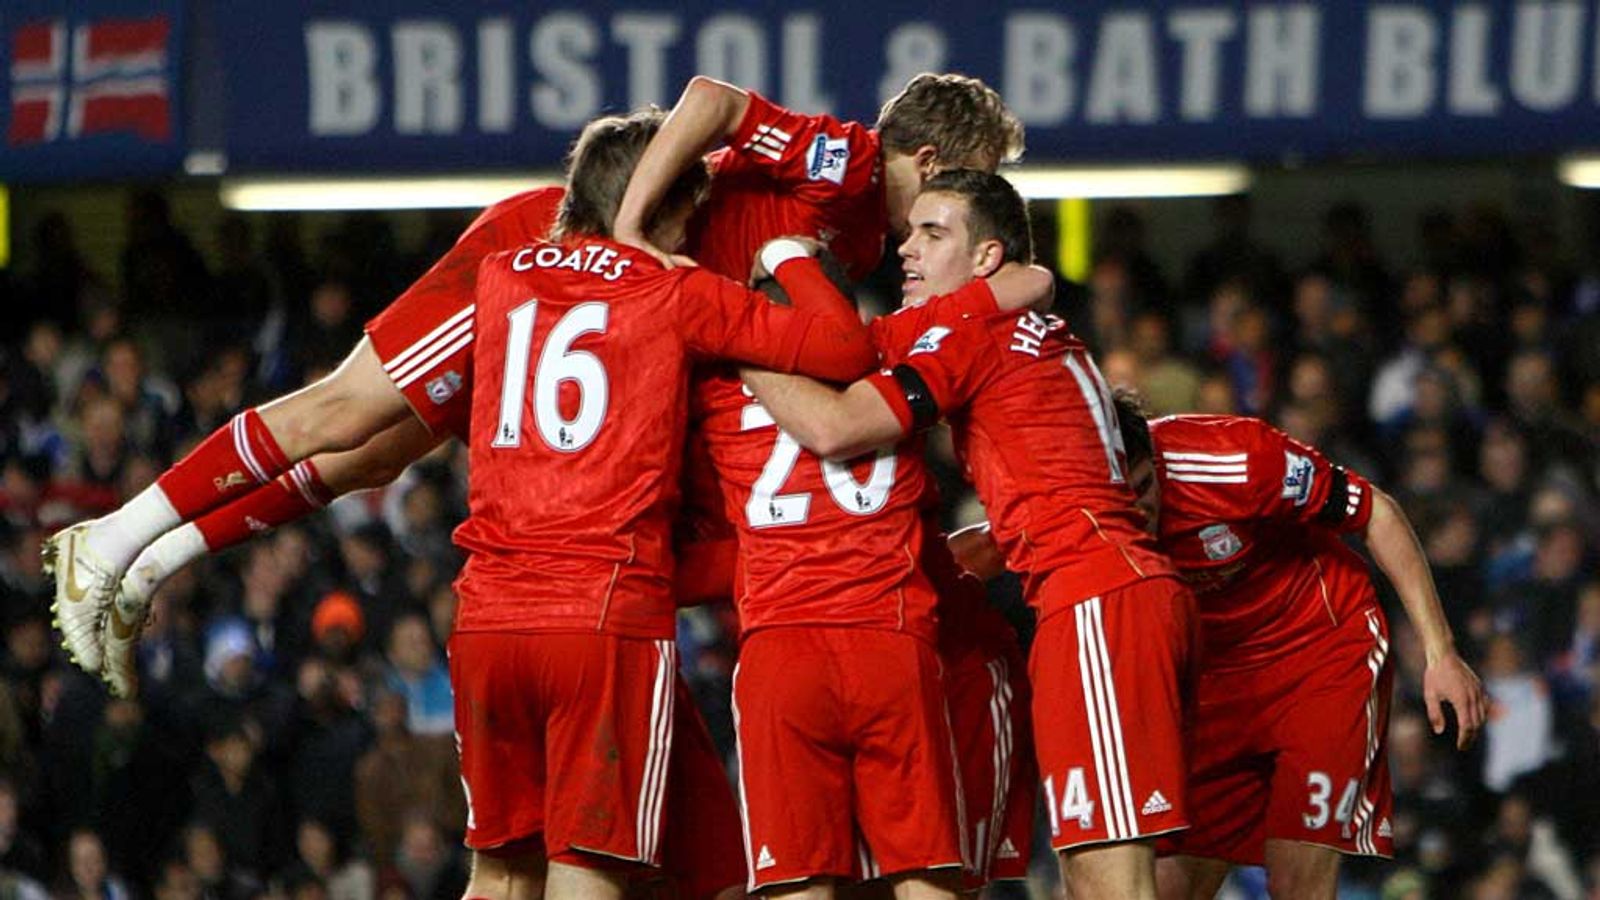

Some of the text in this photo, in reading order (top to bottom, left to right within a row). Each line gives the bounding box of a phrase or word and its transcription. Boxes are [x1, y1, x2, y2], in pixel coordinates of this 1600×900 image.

[306, 14, 834, 136] BRISTOL
[1003, 9, 1322, 126] BATH
[1361, 0, 1600, 119] BLU
[512, 245, 632, 281] COATES
[491, 298, 610, 452] 16
[1043, 767, 1095, 837] 14
[1302, 771, 1359, 839] 34
